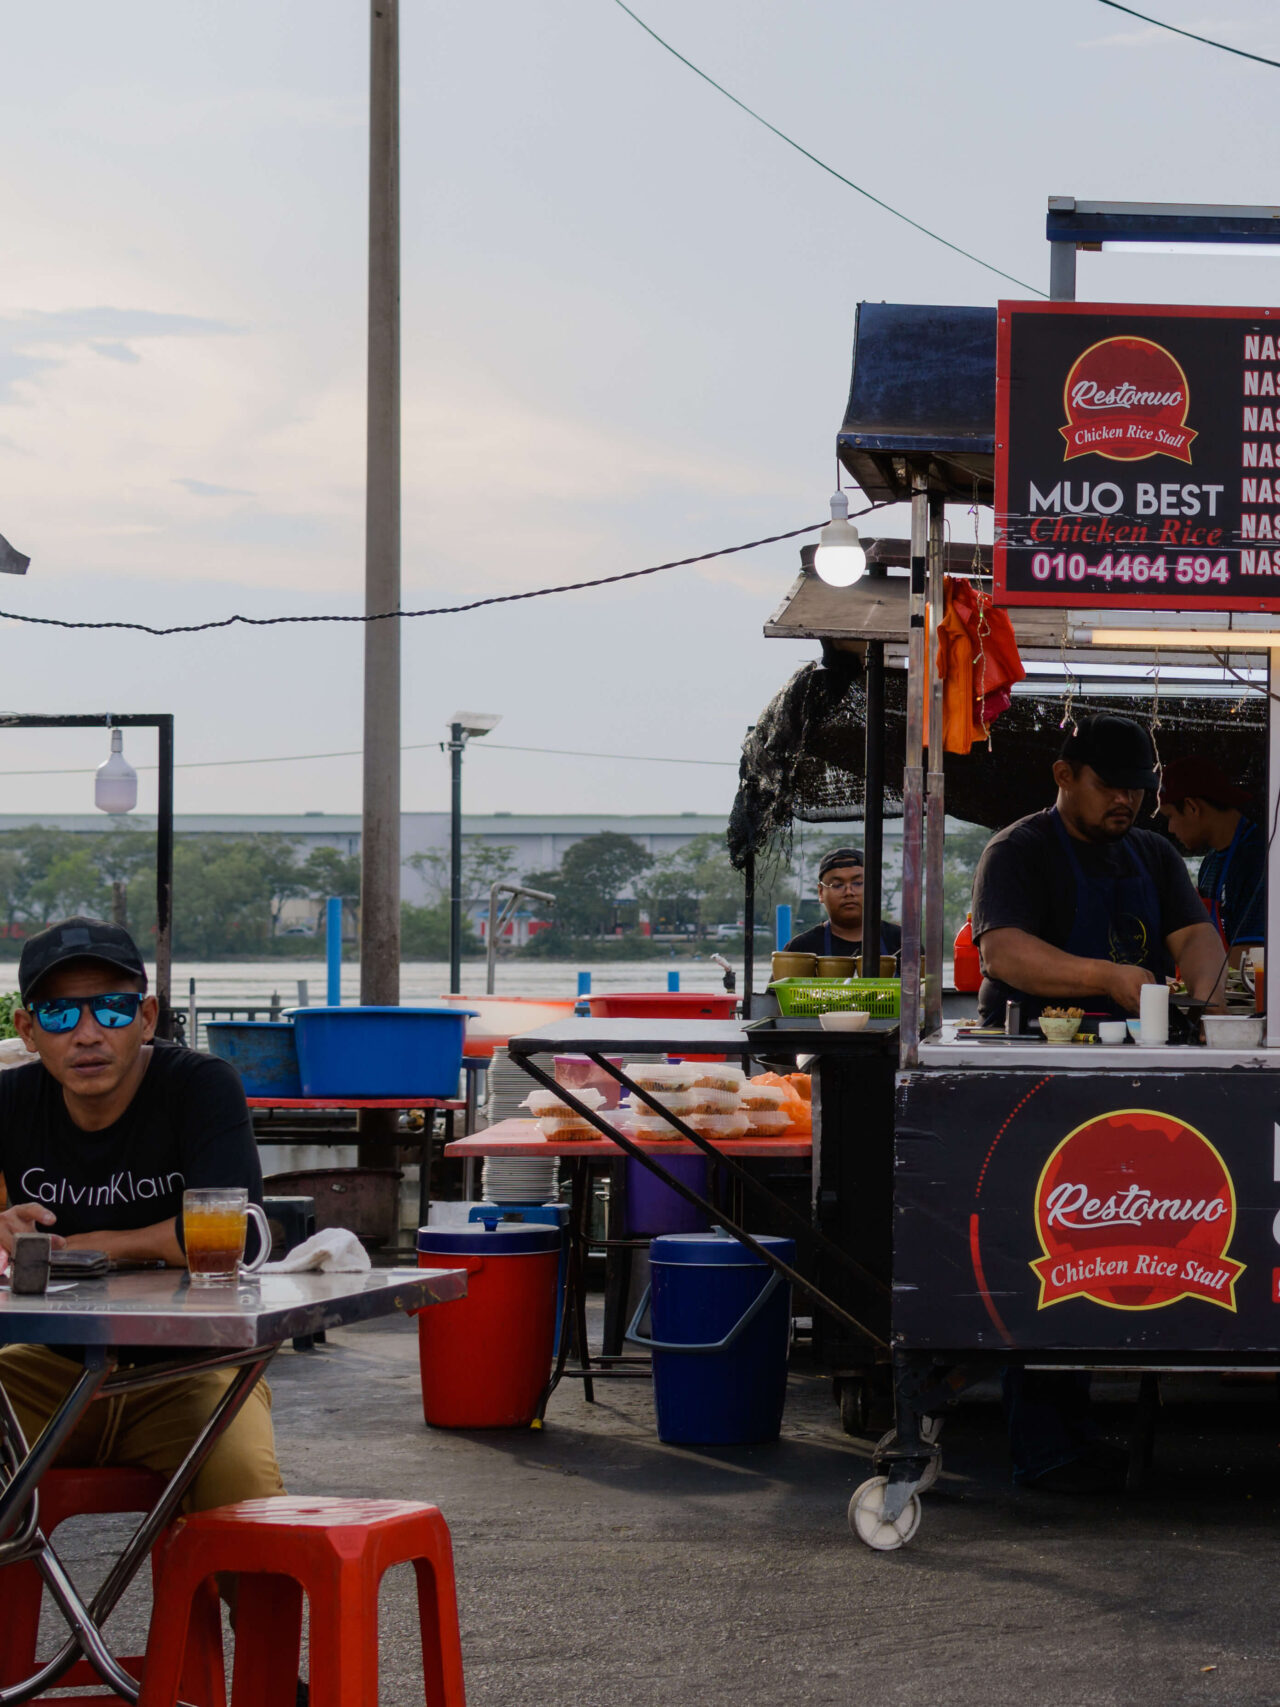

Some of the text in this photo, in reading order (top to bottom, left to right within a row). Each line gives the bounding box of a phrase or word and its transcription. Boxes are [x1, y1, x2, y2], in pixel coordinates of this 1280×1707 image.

[1071, 380, 1183, 410] Restomuo
[1074, 423, 1185, 448] Chicken Rice Stall
[1030, 480, 1224, 516] MUO BEST
[1030, 515, 1223, 547] Chicken Rice
[1032, 552, 1231, 585] 010-4464 594
[1046, 1182, 1227, 1229] Restomuo
[1051, 1254, 1230, 1290] Chicken Rice Stall
